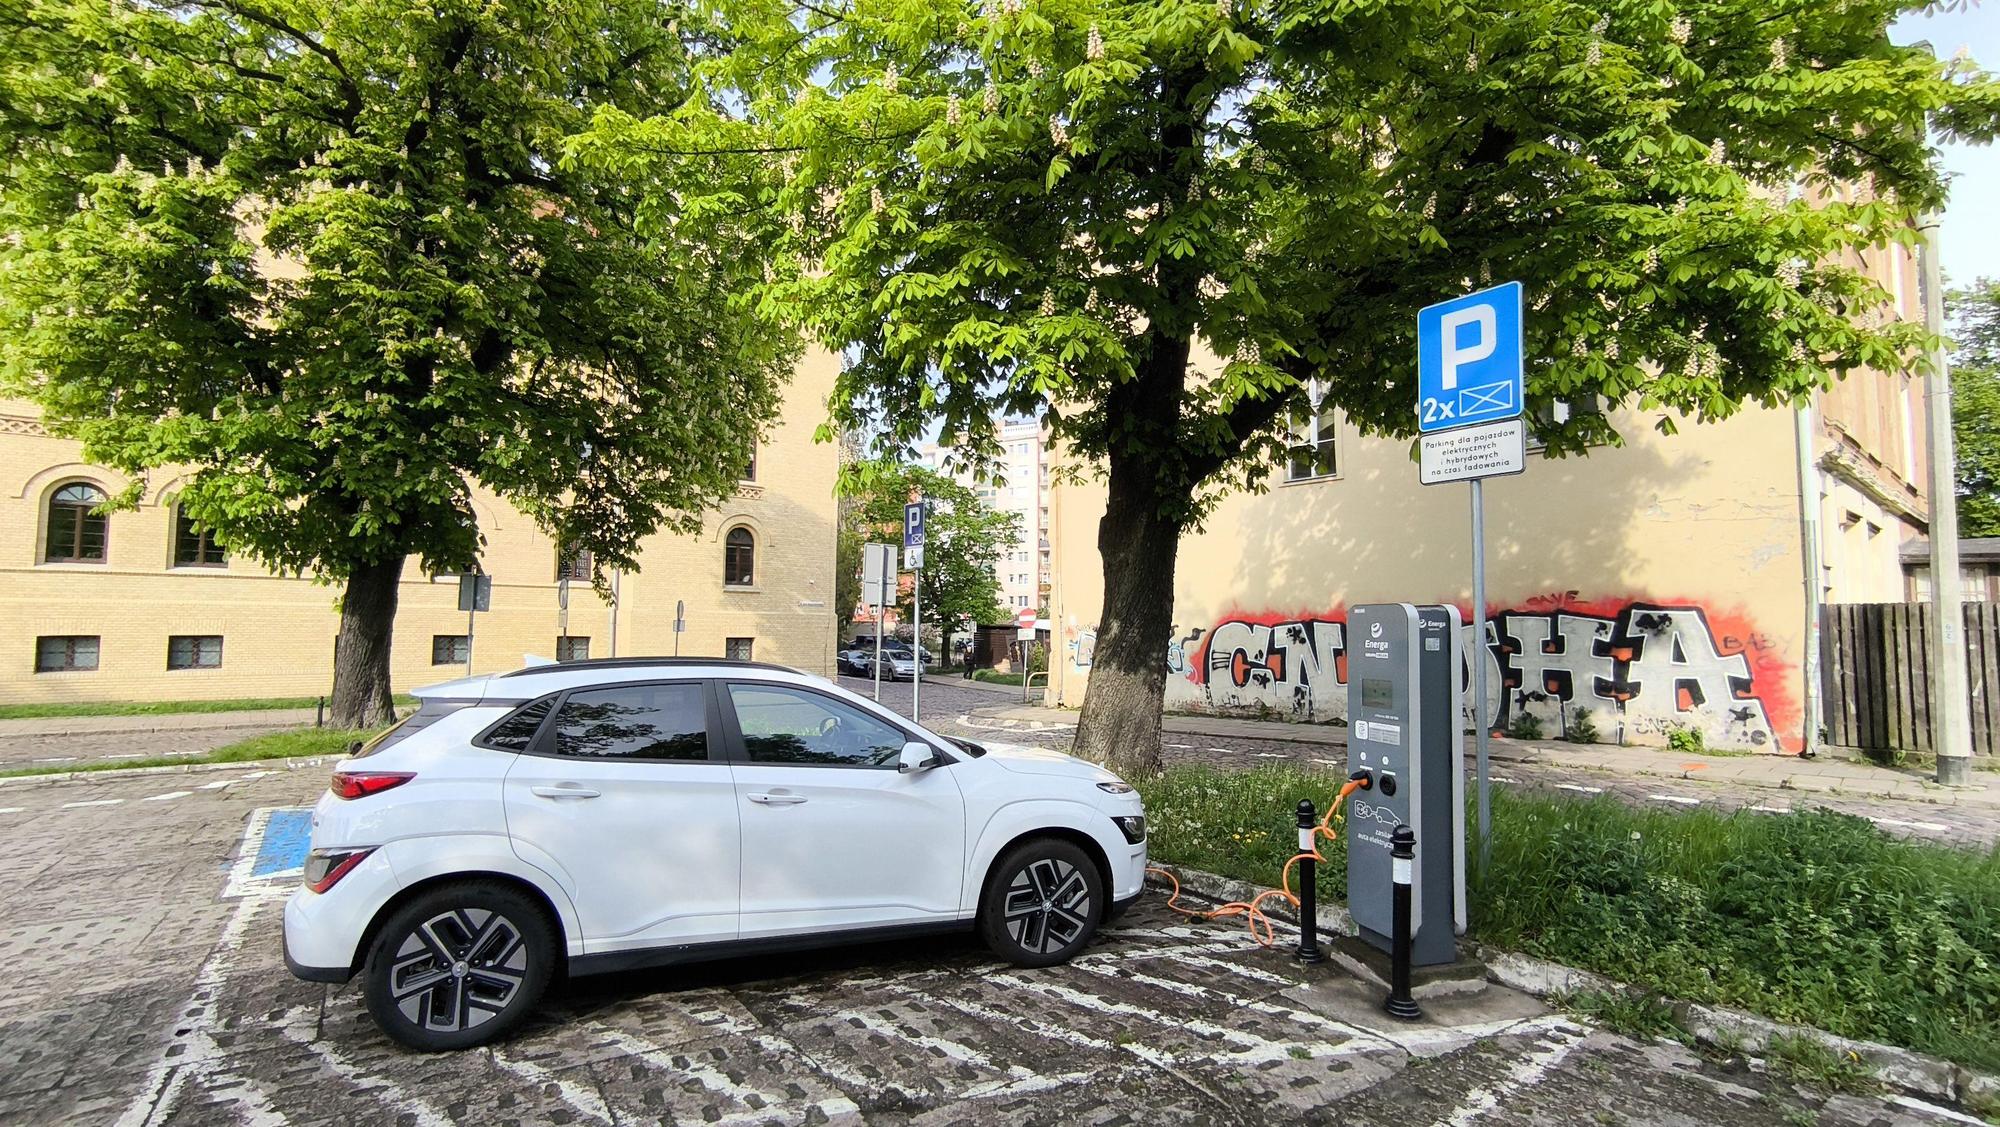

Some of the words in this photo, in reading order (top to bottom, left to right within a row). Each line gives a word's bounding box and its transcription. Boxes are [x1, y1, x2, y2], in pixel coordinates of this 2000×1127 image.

[1441, 304, 1497, 391] P
[1422, 397, 1456, 424] 2x
[1425, 439, 1455, 449] Parking
[1457, 436, 1471, 444] dla
[1442, 441, 1497, 456] elektrycznych
[1446, 451, 1499, 465] hybrydowych
[908, 506, 920, 535] P
[1364, 639, 1389, 651] Energa
